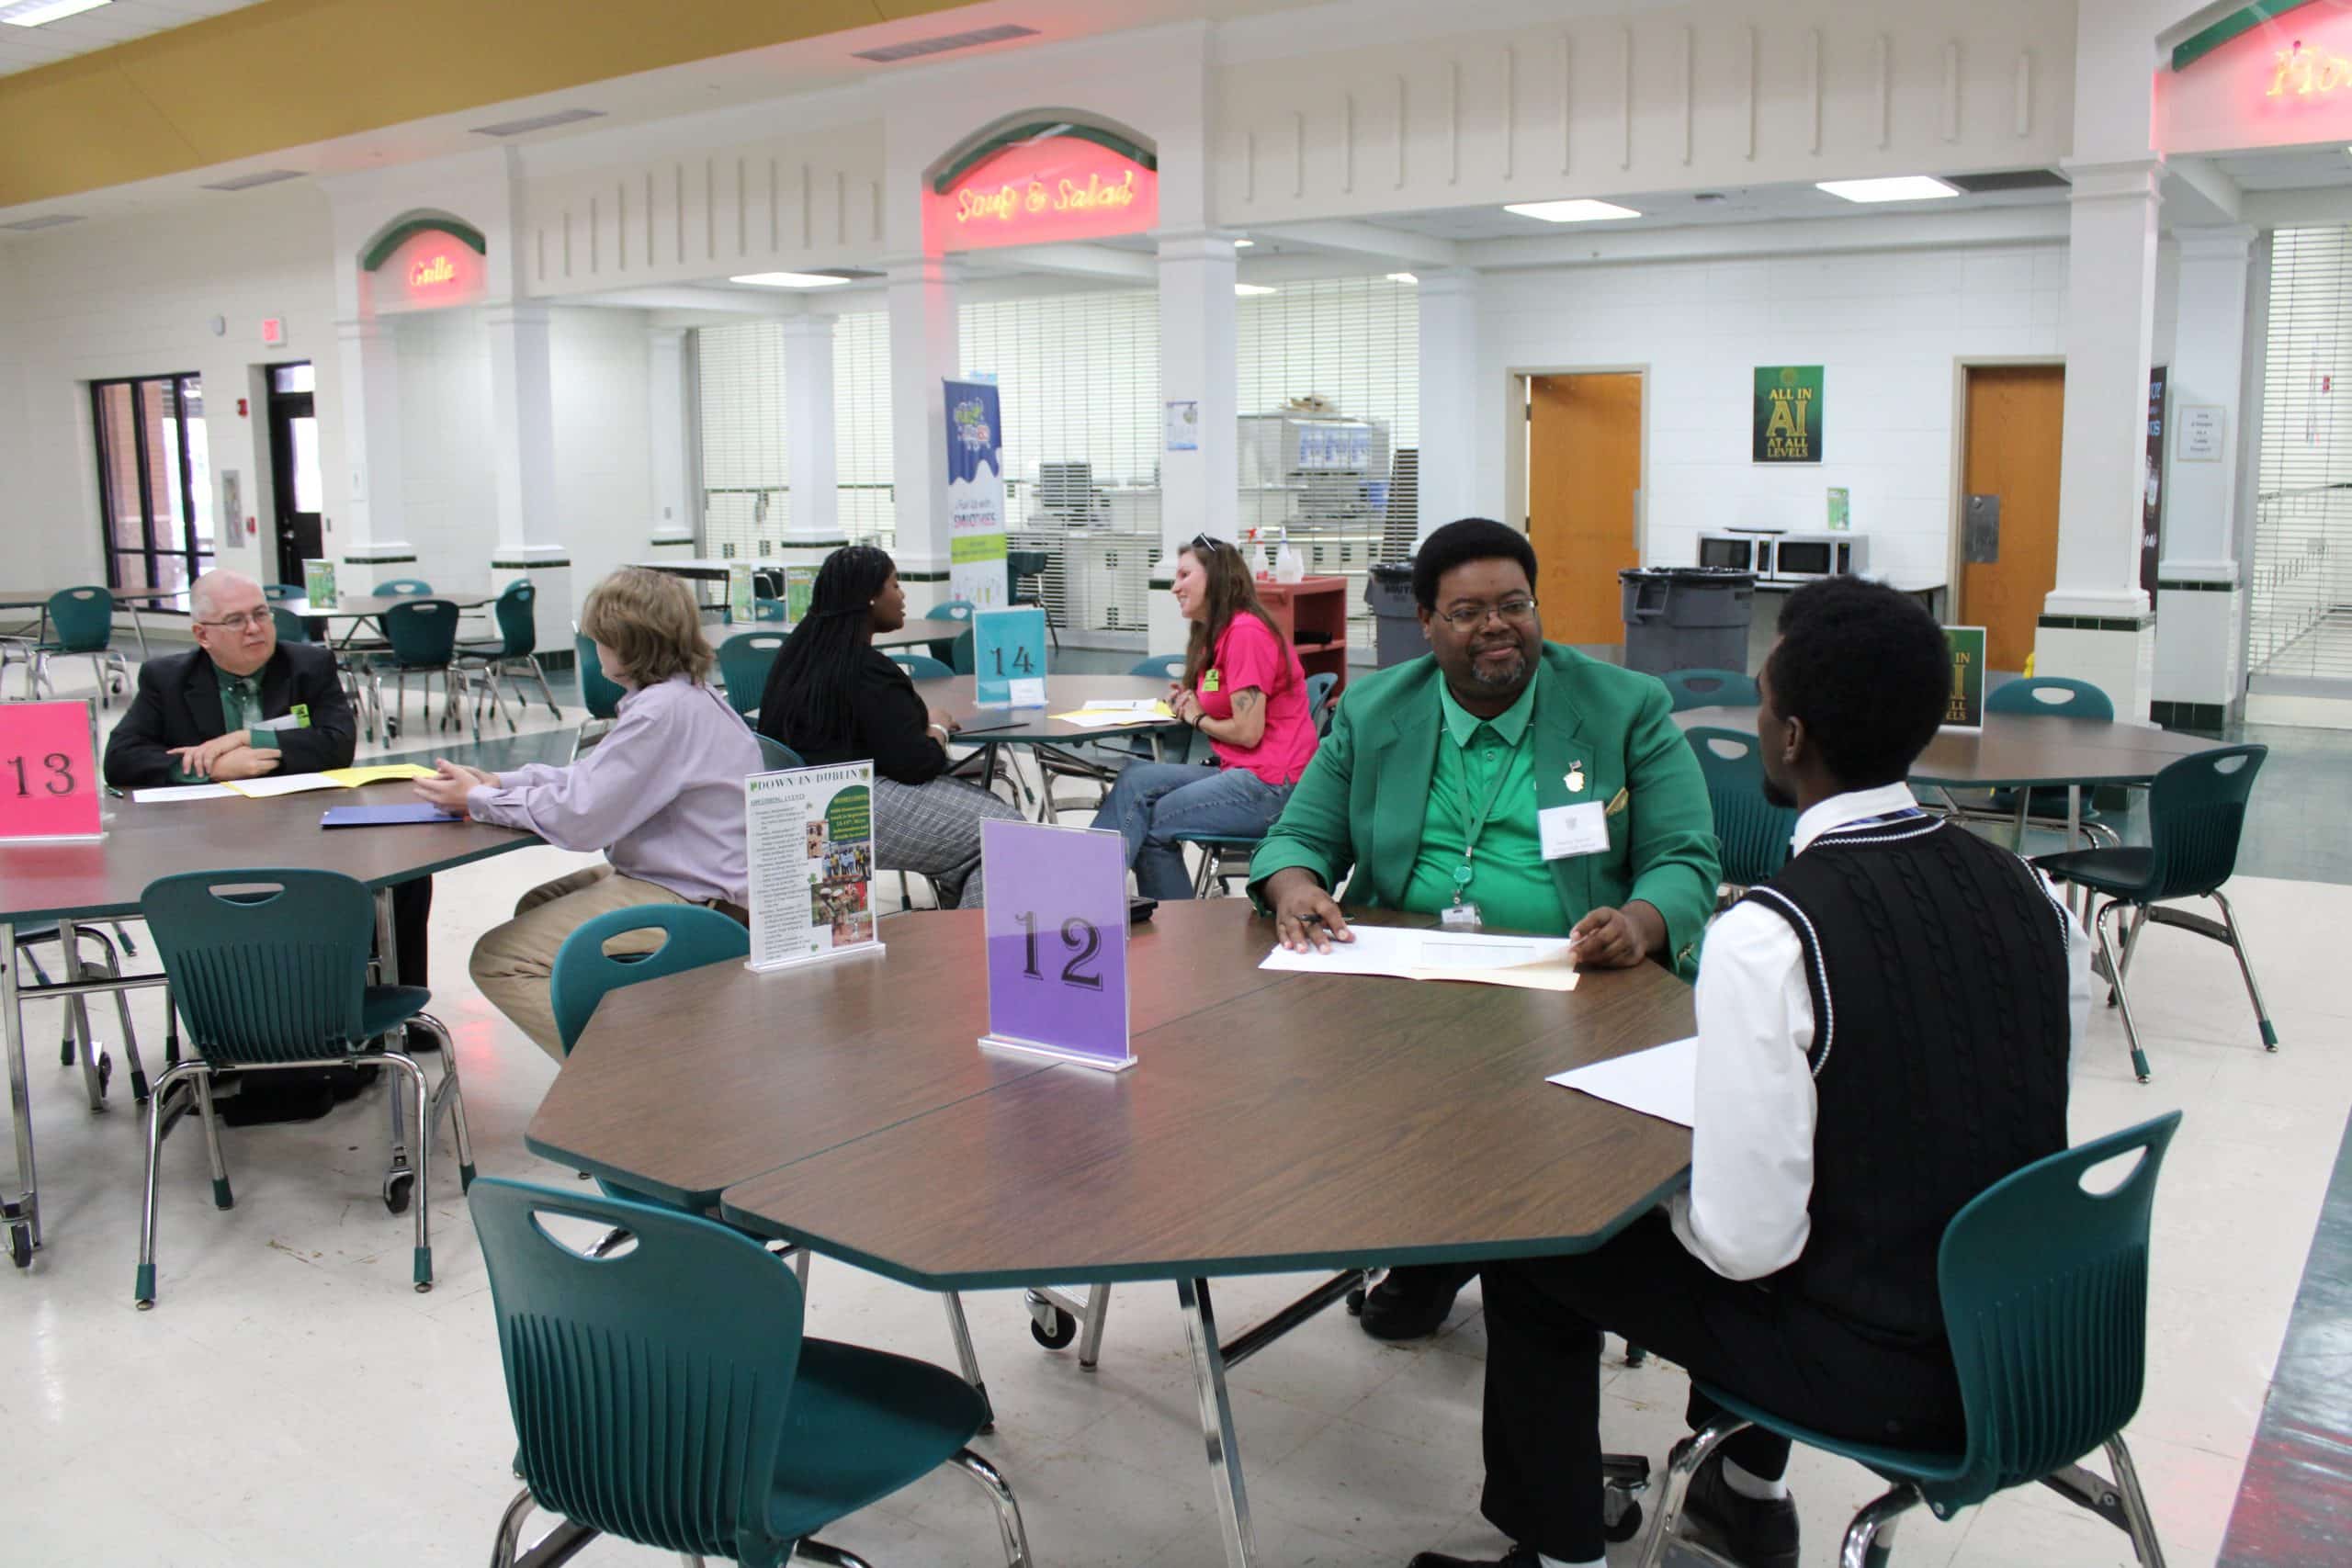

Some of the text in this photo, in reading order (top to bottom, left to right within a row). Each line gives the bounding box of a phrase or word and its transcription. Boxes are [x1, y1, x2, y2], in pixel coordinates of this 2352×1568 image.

[956, 169, 1134, 222] Soup & Salad
[1770, 388, 1813, 400] ALL IN
[1766, 400, 1808, 436] AI
[1767, 446, 1809, 457] LEVELS
[1768, 436, 1809, 448] AT ALL
[989, 646, 1035, 676] 14
[1955, 651, 1971, 663] IN
[1950, 699, 1965, 711] LL
[7, 753, 74, 797] 13
[758, 769, 858, 791] DOWN IN DUBLIN
[1015, 911, 1103, 992] 12
